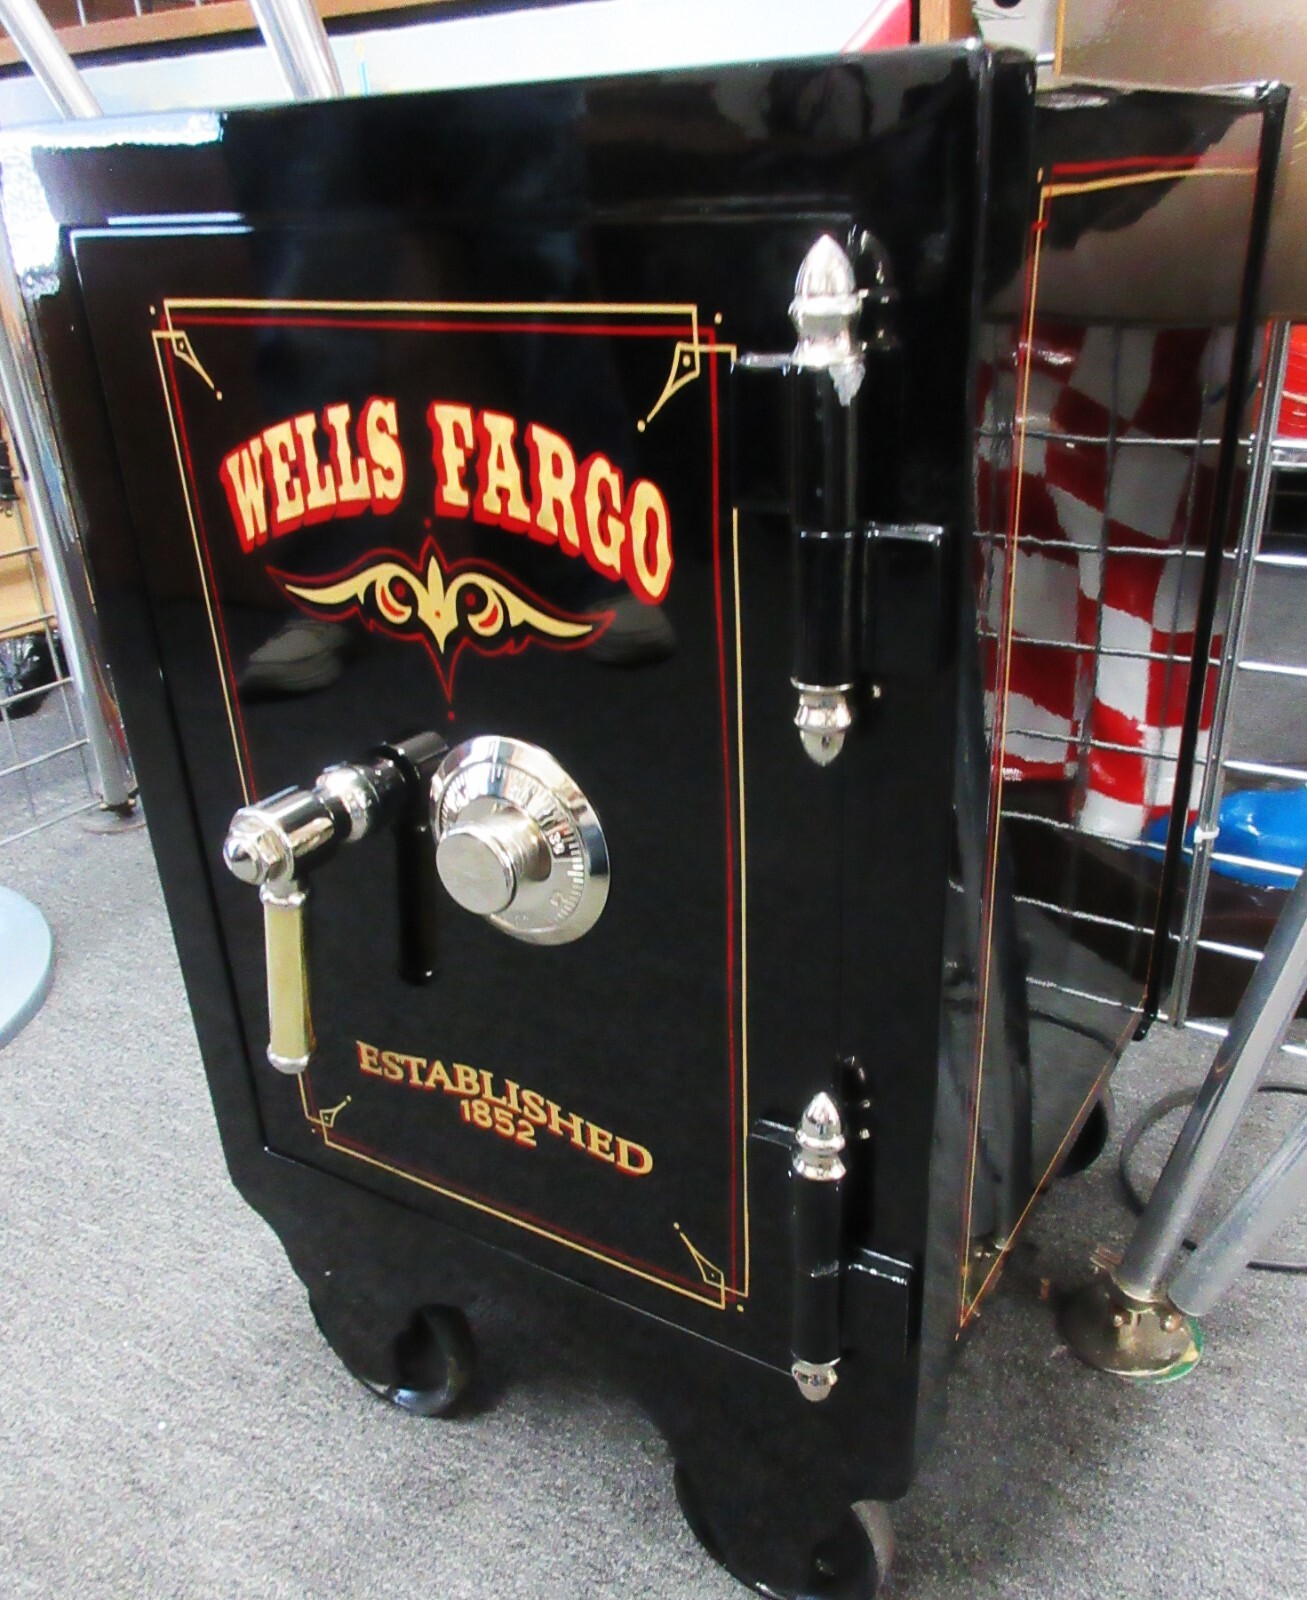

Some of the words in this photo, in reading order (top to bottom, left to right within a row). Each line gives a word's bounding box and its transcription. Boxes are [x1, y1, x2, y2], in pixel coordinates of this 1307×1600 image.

[219, 394, 405, 554] WELLS
[427, 400, 674, 605] FARGO
[355, 1039, 654, 1176] ESTABLISHED
[460, 1098, 538, 1147] 1852
